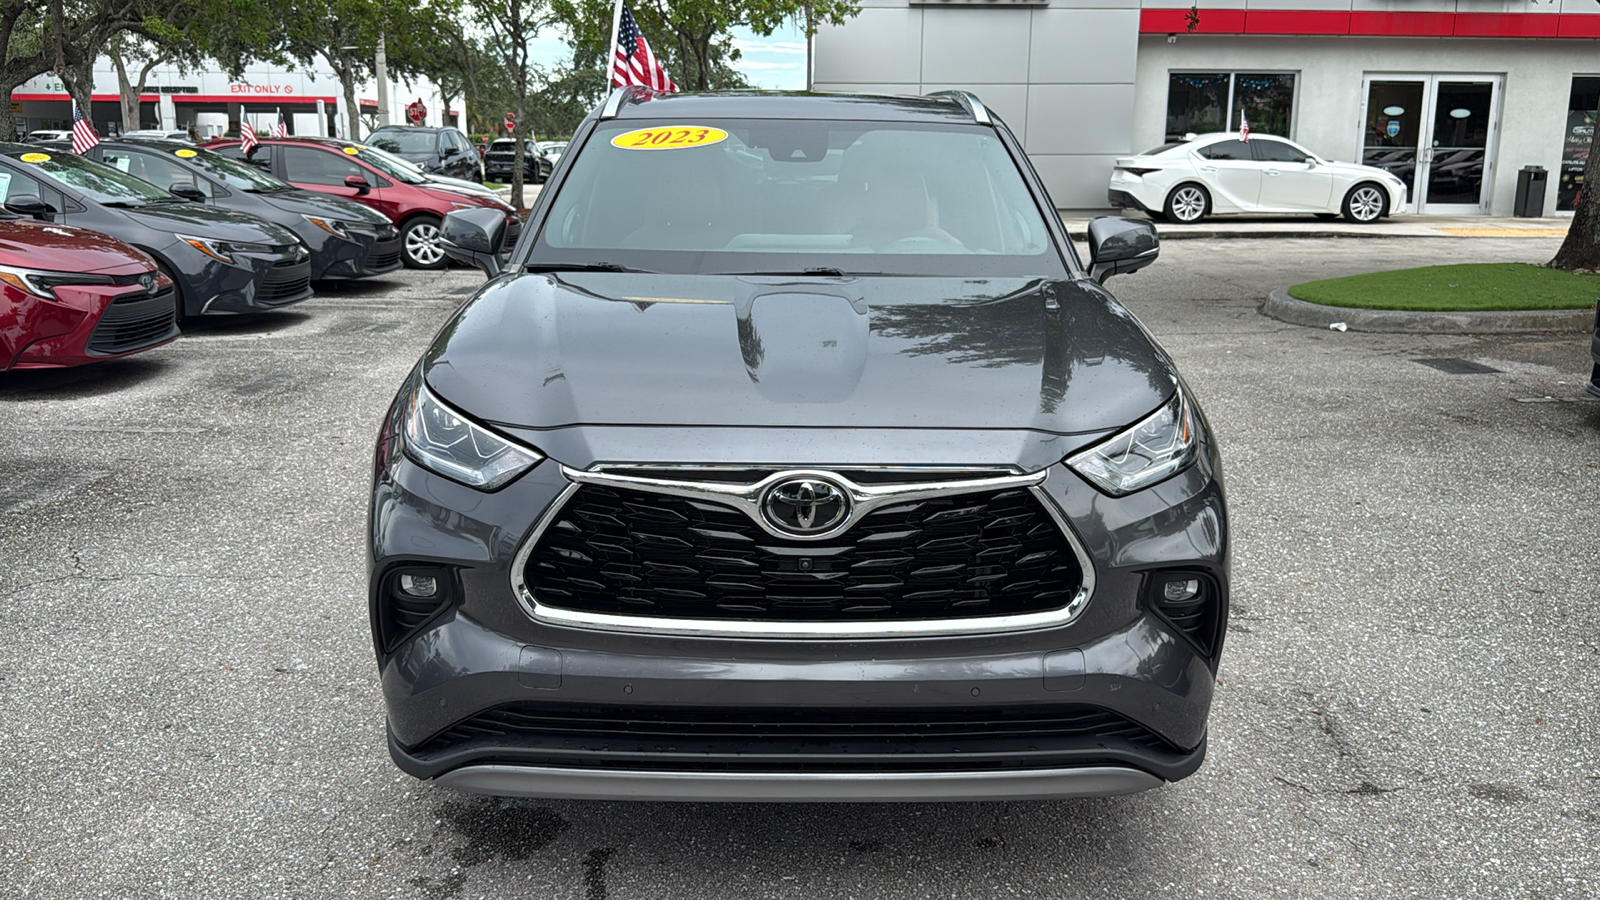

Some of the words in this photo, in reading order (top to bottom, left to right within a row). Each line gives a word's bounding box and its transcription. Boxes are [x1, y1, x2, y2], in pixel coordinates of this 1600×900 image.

[230, 84, 251, 93] EXIT
[254, 84, 280, 93] ONLY
[630, 129, 710, 147] 2023
